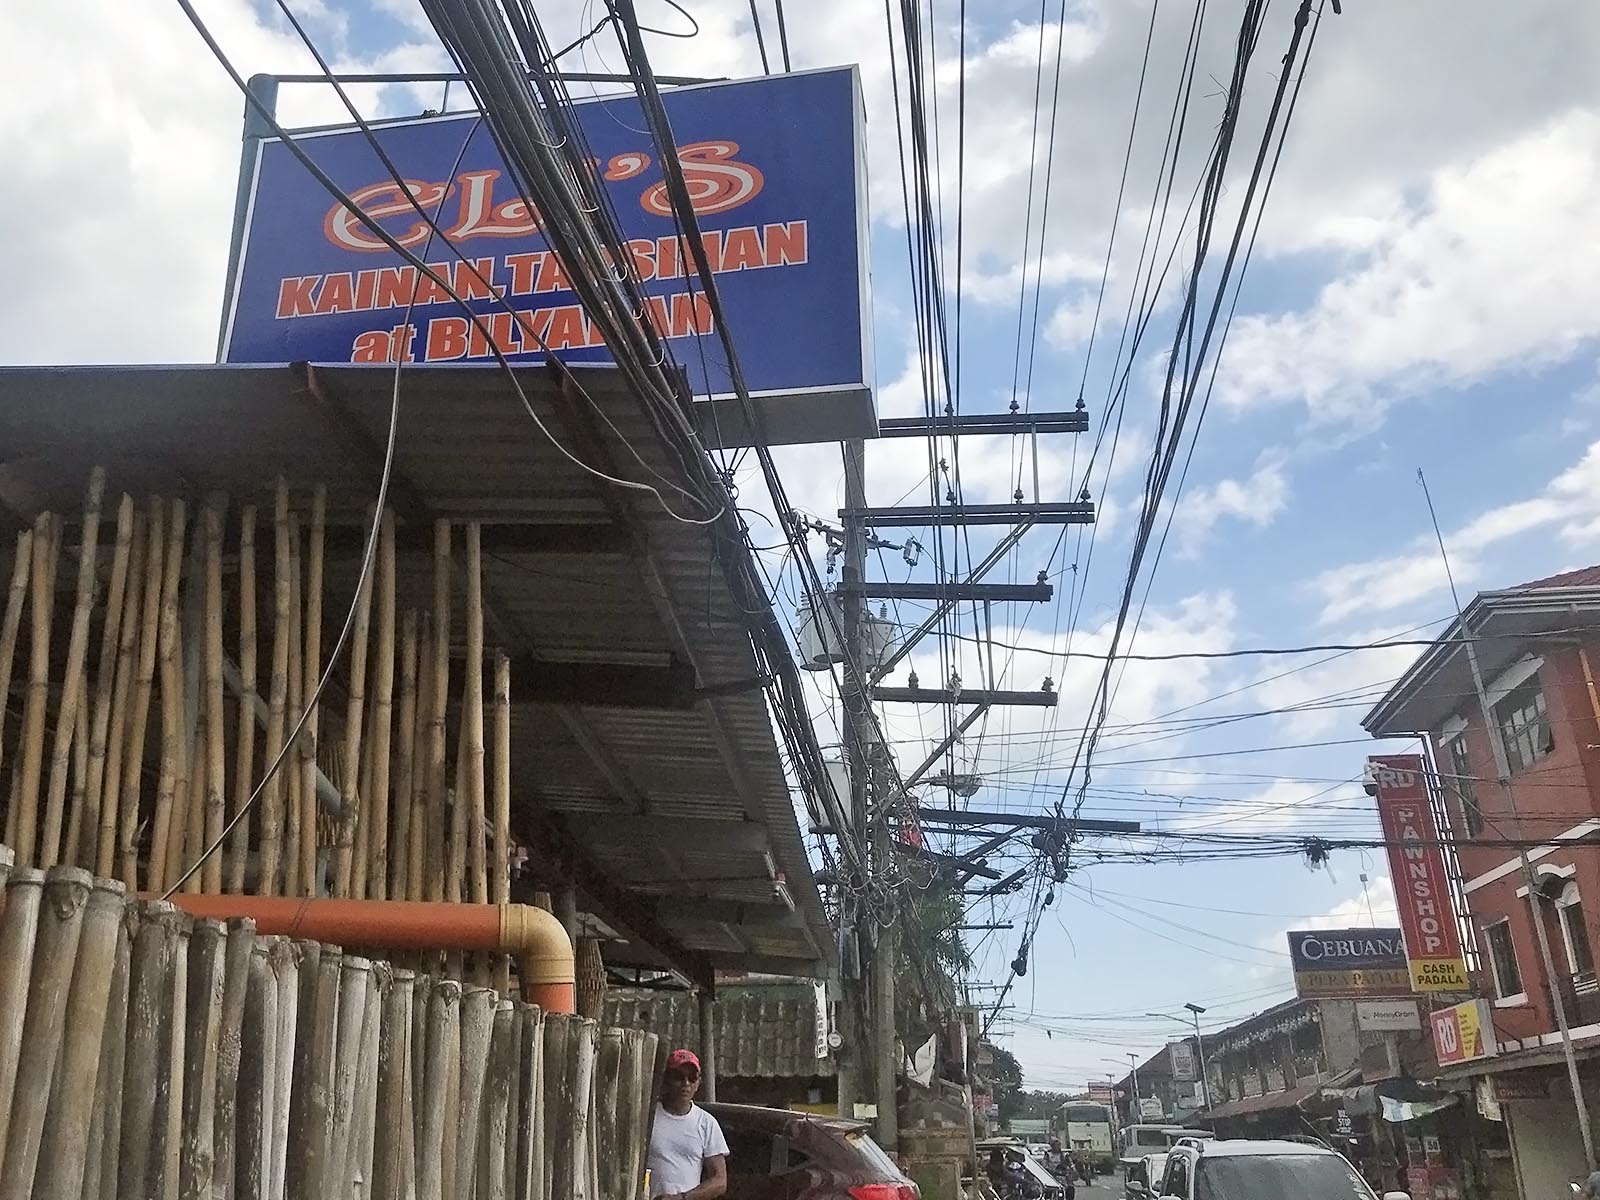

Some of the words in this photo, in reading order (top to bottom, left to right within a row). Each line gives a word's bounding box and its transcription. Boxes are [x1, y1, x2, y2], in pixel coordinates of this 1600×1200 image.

[351, 324, 416, 362] at
[425, 291, 714, 362] BILYAAN
[1380, 768, 1415, 789] RD
[1398, 807, 1441, 954] PAWNSHOP
[1301, 935, 1404, 960] CEBUANA
[1418, 974, 1463, 985] PADALA
[1422, 963, 1455, 974] CASH
[1373, 1010, 1416, 1020] MoneyGram
[1437, 1017, 1457, 1054] RD
